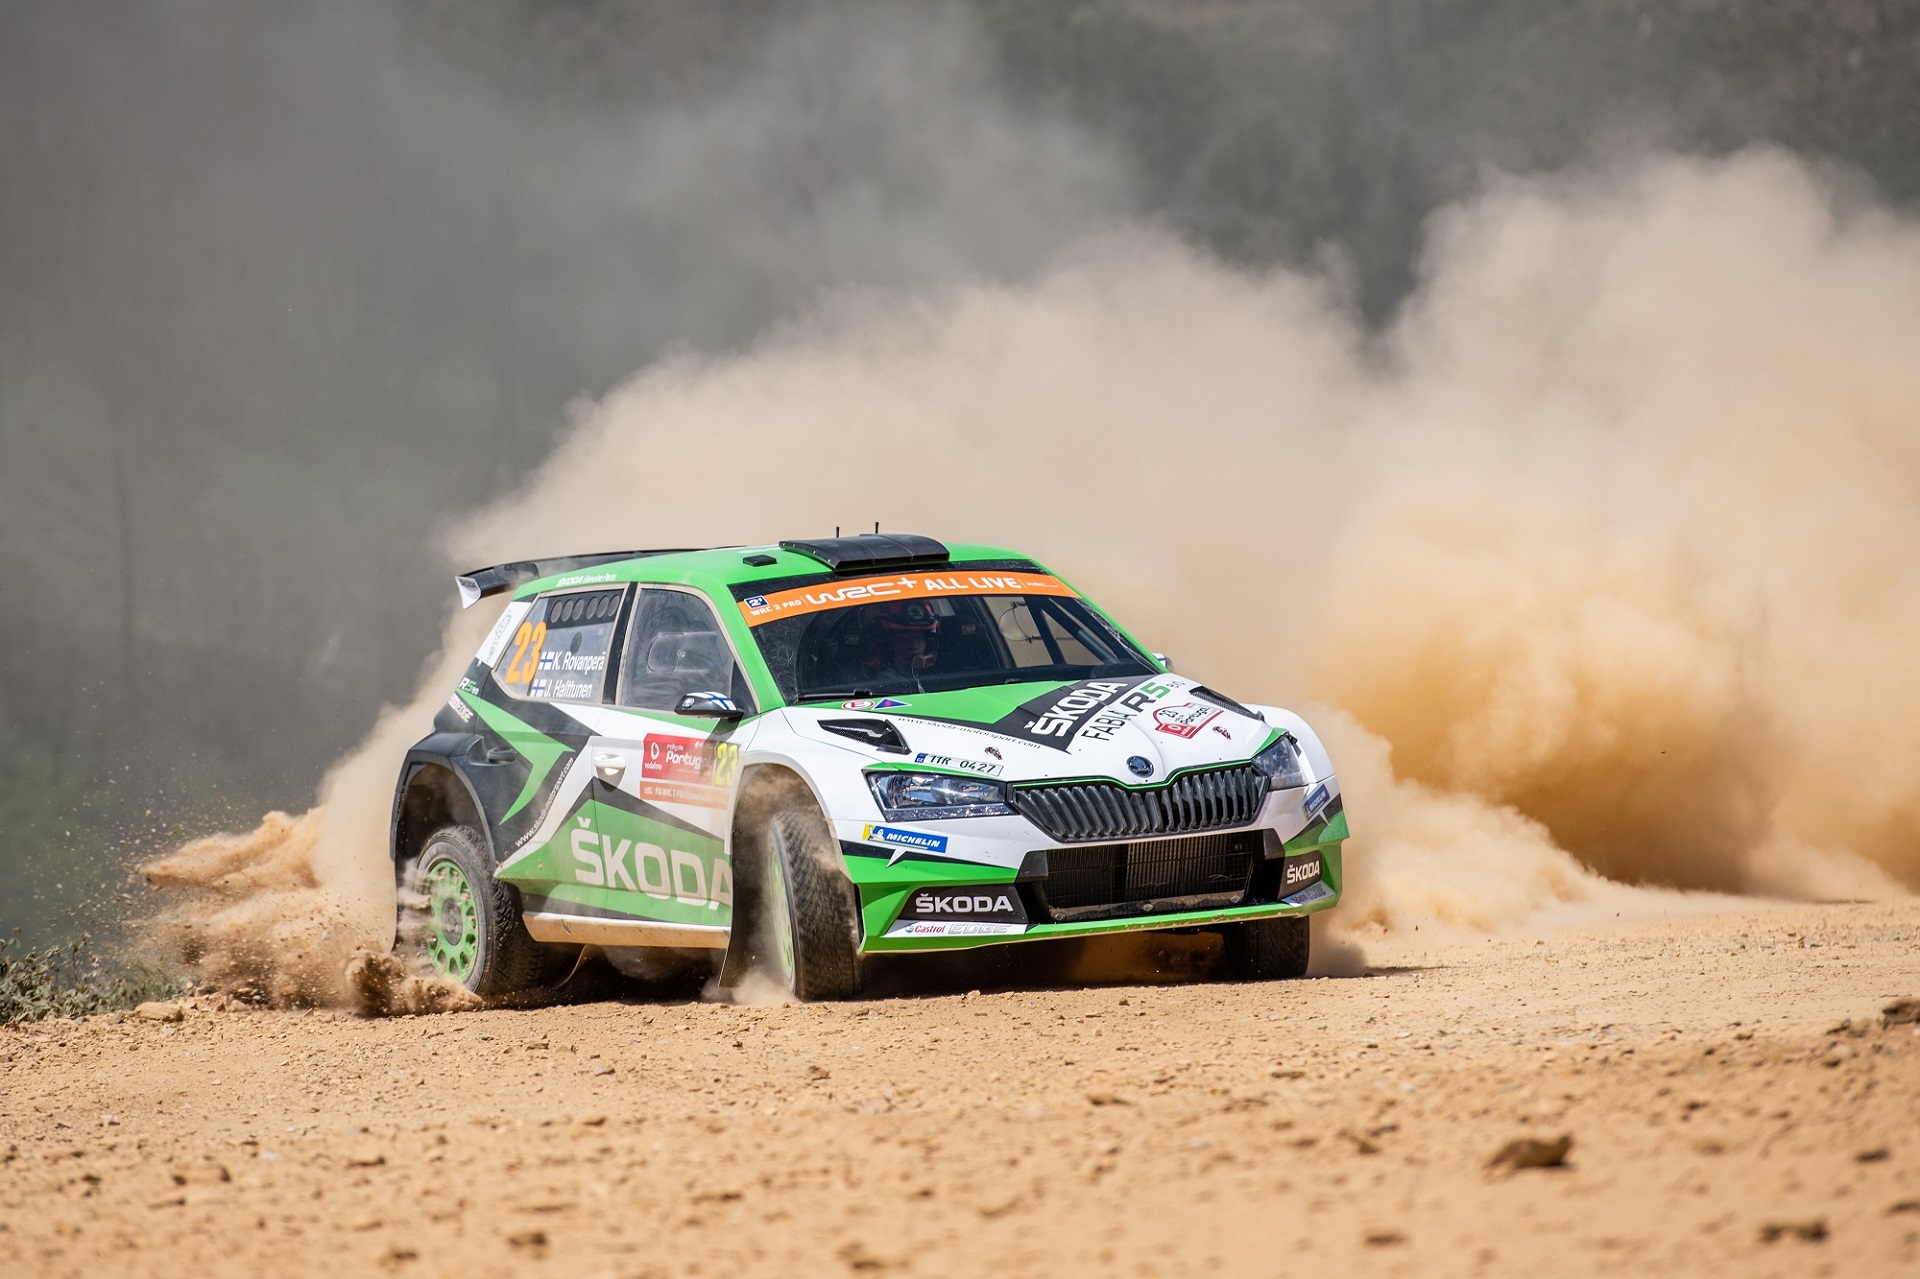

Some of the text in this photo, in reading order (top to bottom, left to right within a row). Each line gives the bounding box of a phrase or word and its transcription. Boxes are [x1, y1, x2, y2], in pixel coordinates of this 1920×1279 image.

[923, 578, 969, 591] ALL
[968, 577, 1023, 589] LIVE
[750, 606, 774, 616] WRC
[783, 600, 803, 609] PRO
[505, 621, 547, 684] 23
[551, 651, 606, 675] K. Rovanperä
[544, 679, 593, 698] J. Halttunen
[1024, 681, 1129, 737] ŠKODA
[1081, 710, 1138, 742] FABIA
[1120, 682, 1170, 713] R5
[715, 742, 738, 787] 23
[960, 760, 997, 773] 0427
[886, 833, 941, 848] MICHELIN
[570, 816, 733, 911] ŠKODA
[1286, 860, 1320, 885] ŠKODA
[915, 892, 1014, 913] ŠKODA
[914, 923, 1012, 935] Castrol EDGE
